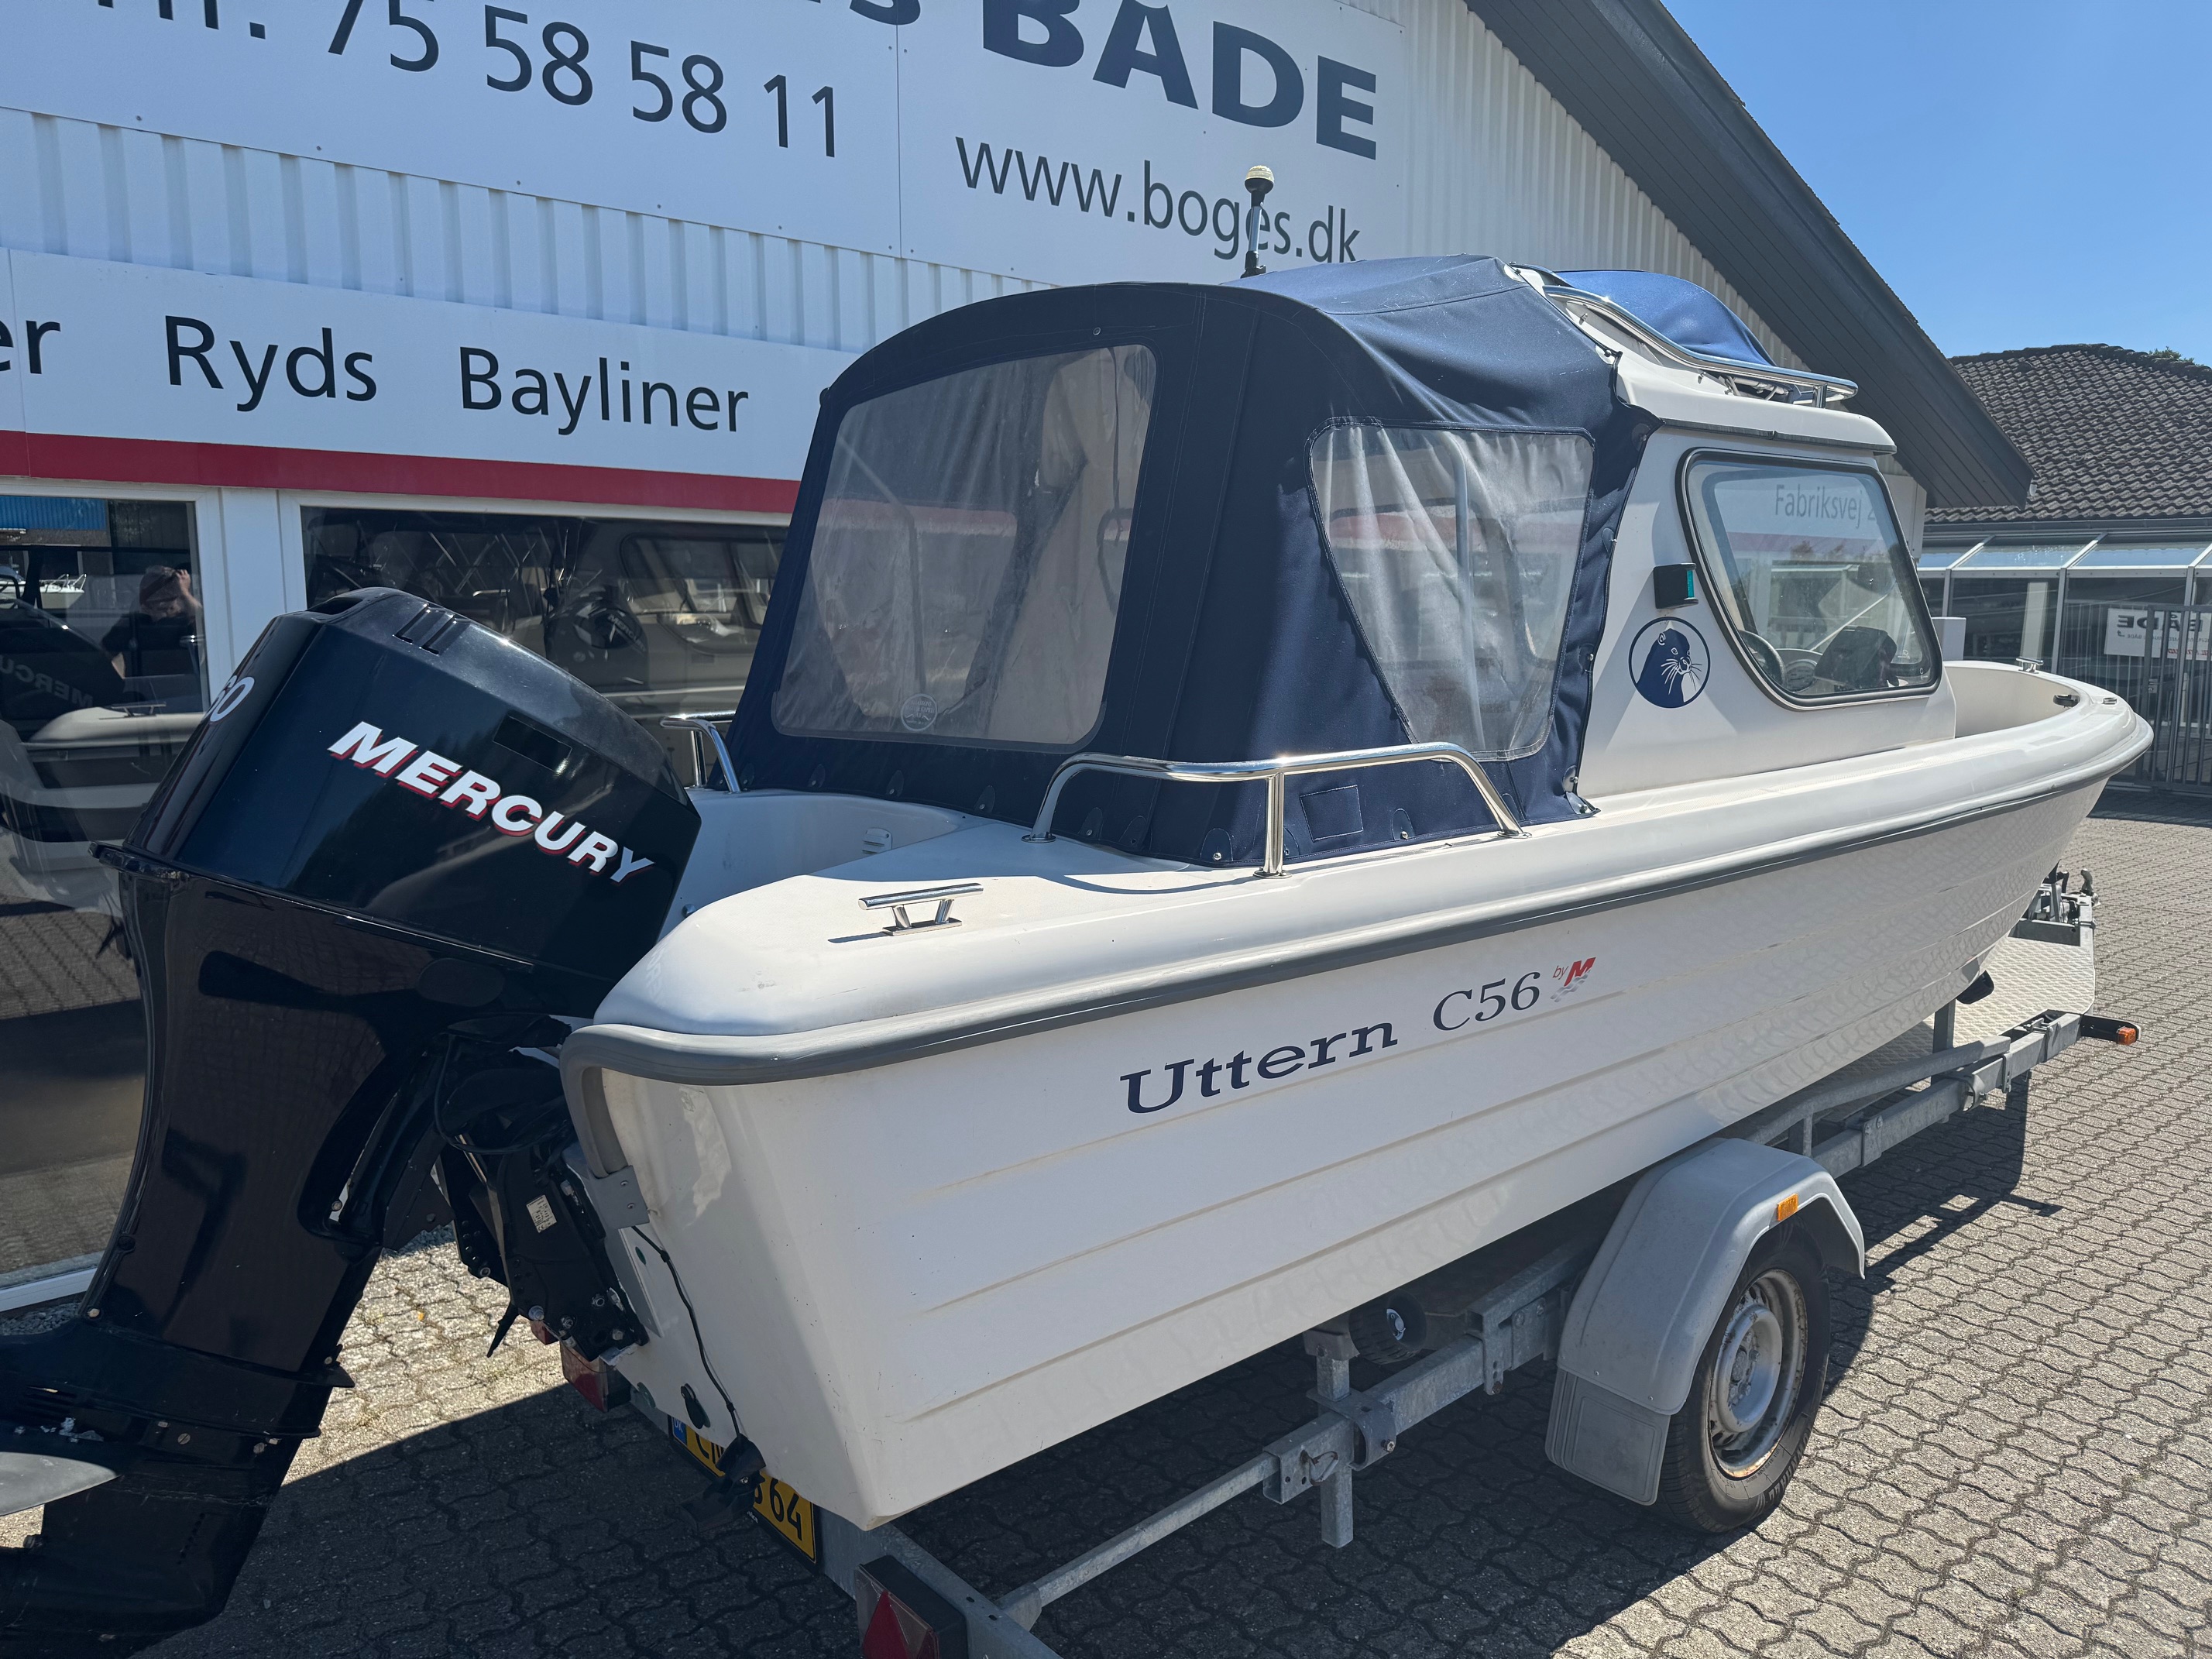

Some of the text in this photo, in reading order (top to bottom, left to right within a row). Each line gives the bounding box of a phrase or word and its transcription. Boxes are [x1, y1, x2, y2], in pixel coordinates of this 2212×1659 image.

[484, 4, 593, 106] 58
[630, 40, 727, 134] 58
[764, 74, 835, 156] 11
[955, 136, 1361, 263] www.boges.dk
[165, 315, 377, 412] Ryds
[459, 346, 749, 436] Bayliner
[1775, 483, 1863, 529] Fabriksvej
[326, 720, 654, 884] MERCURY
[1119, 1022, 1398, 1114] Uttern
[1433, 971, 1540, 1031] C56
[1552, 965, 1569, 981] by
